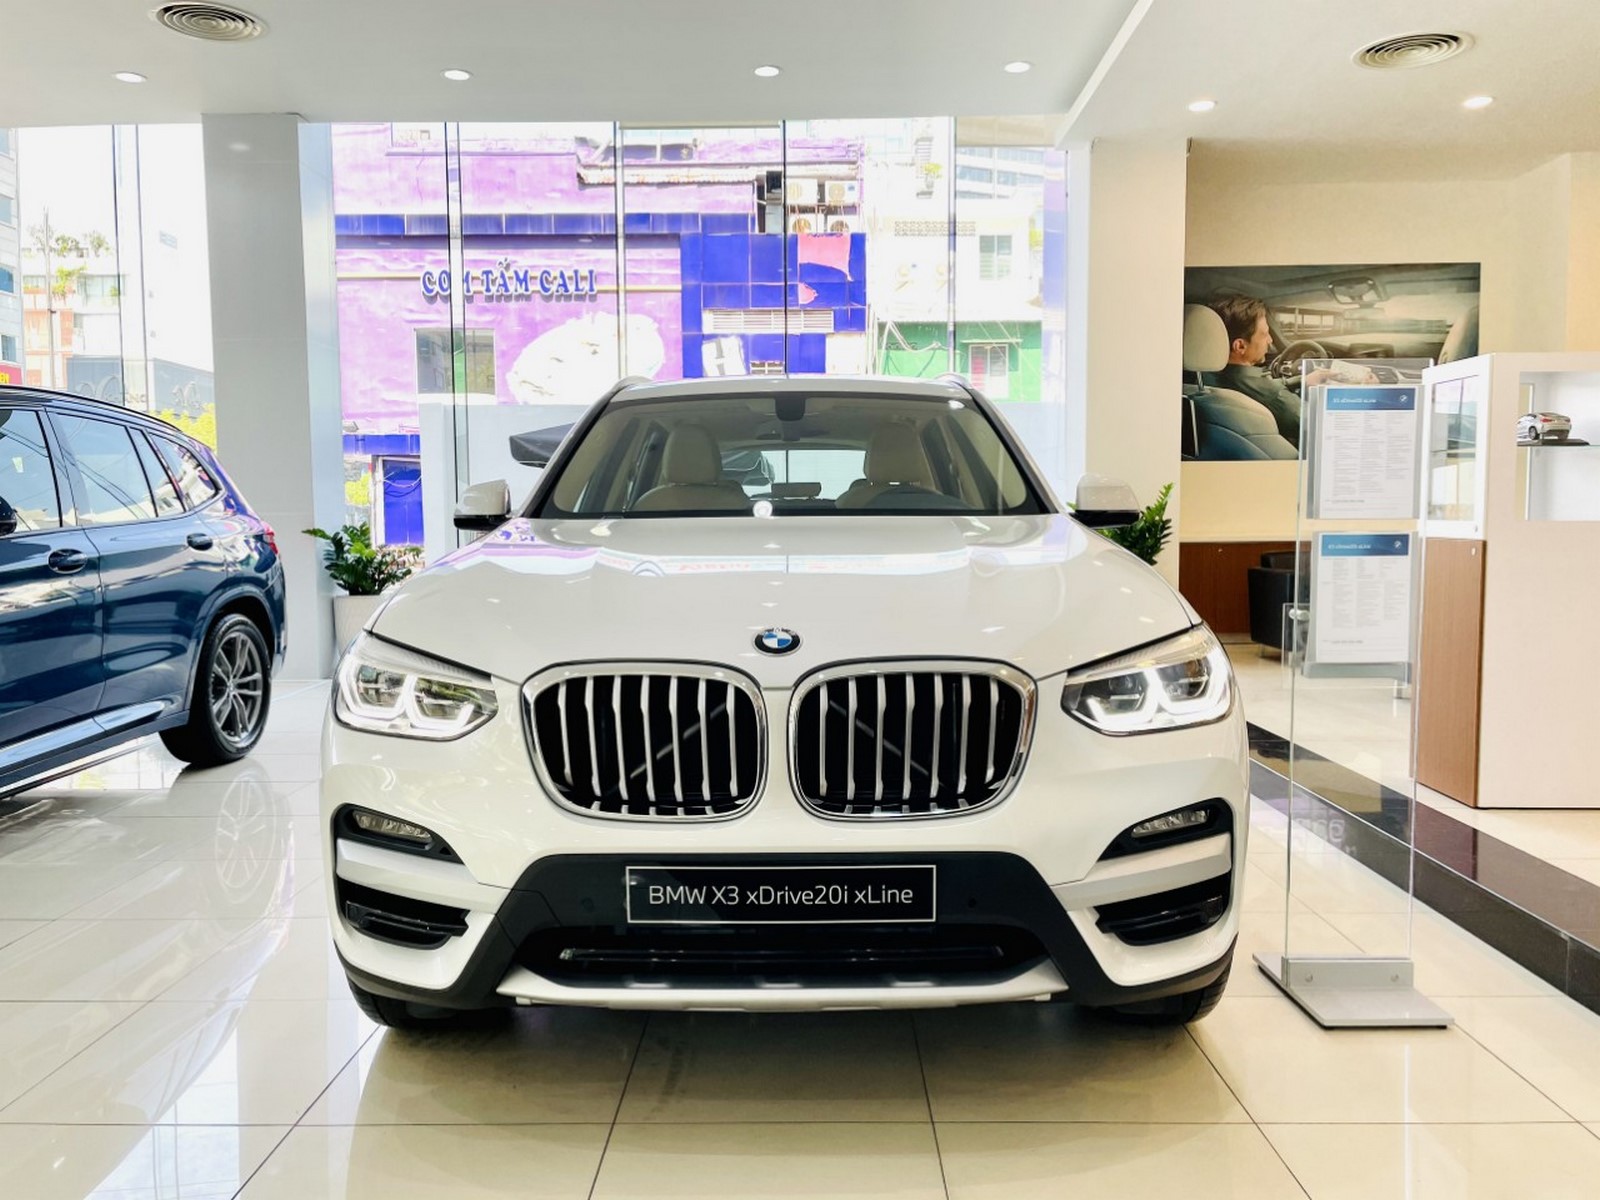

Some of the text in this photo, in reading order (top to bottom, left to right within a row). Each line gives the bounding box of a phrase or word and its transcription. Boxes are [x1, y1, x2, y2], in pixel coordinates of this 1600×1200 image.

[538, 269, 596, 294] CALI
[648, 884, 914, 905] BMW X3 xDrive20i xLine
